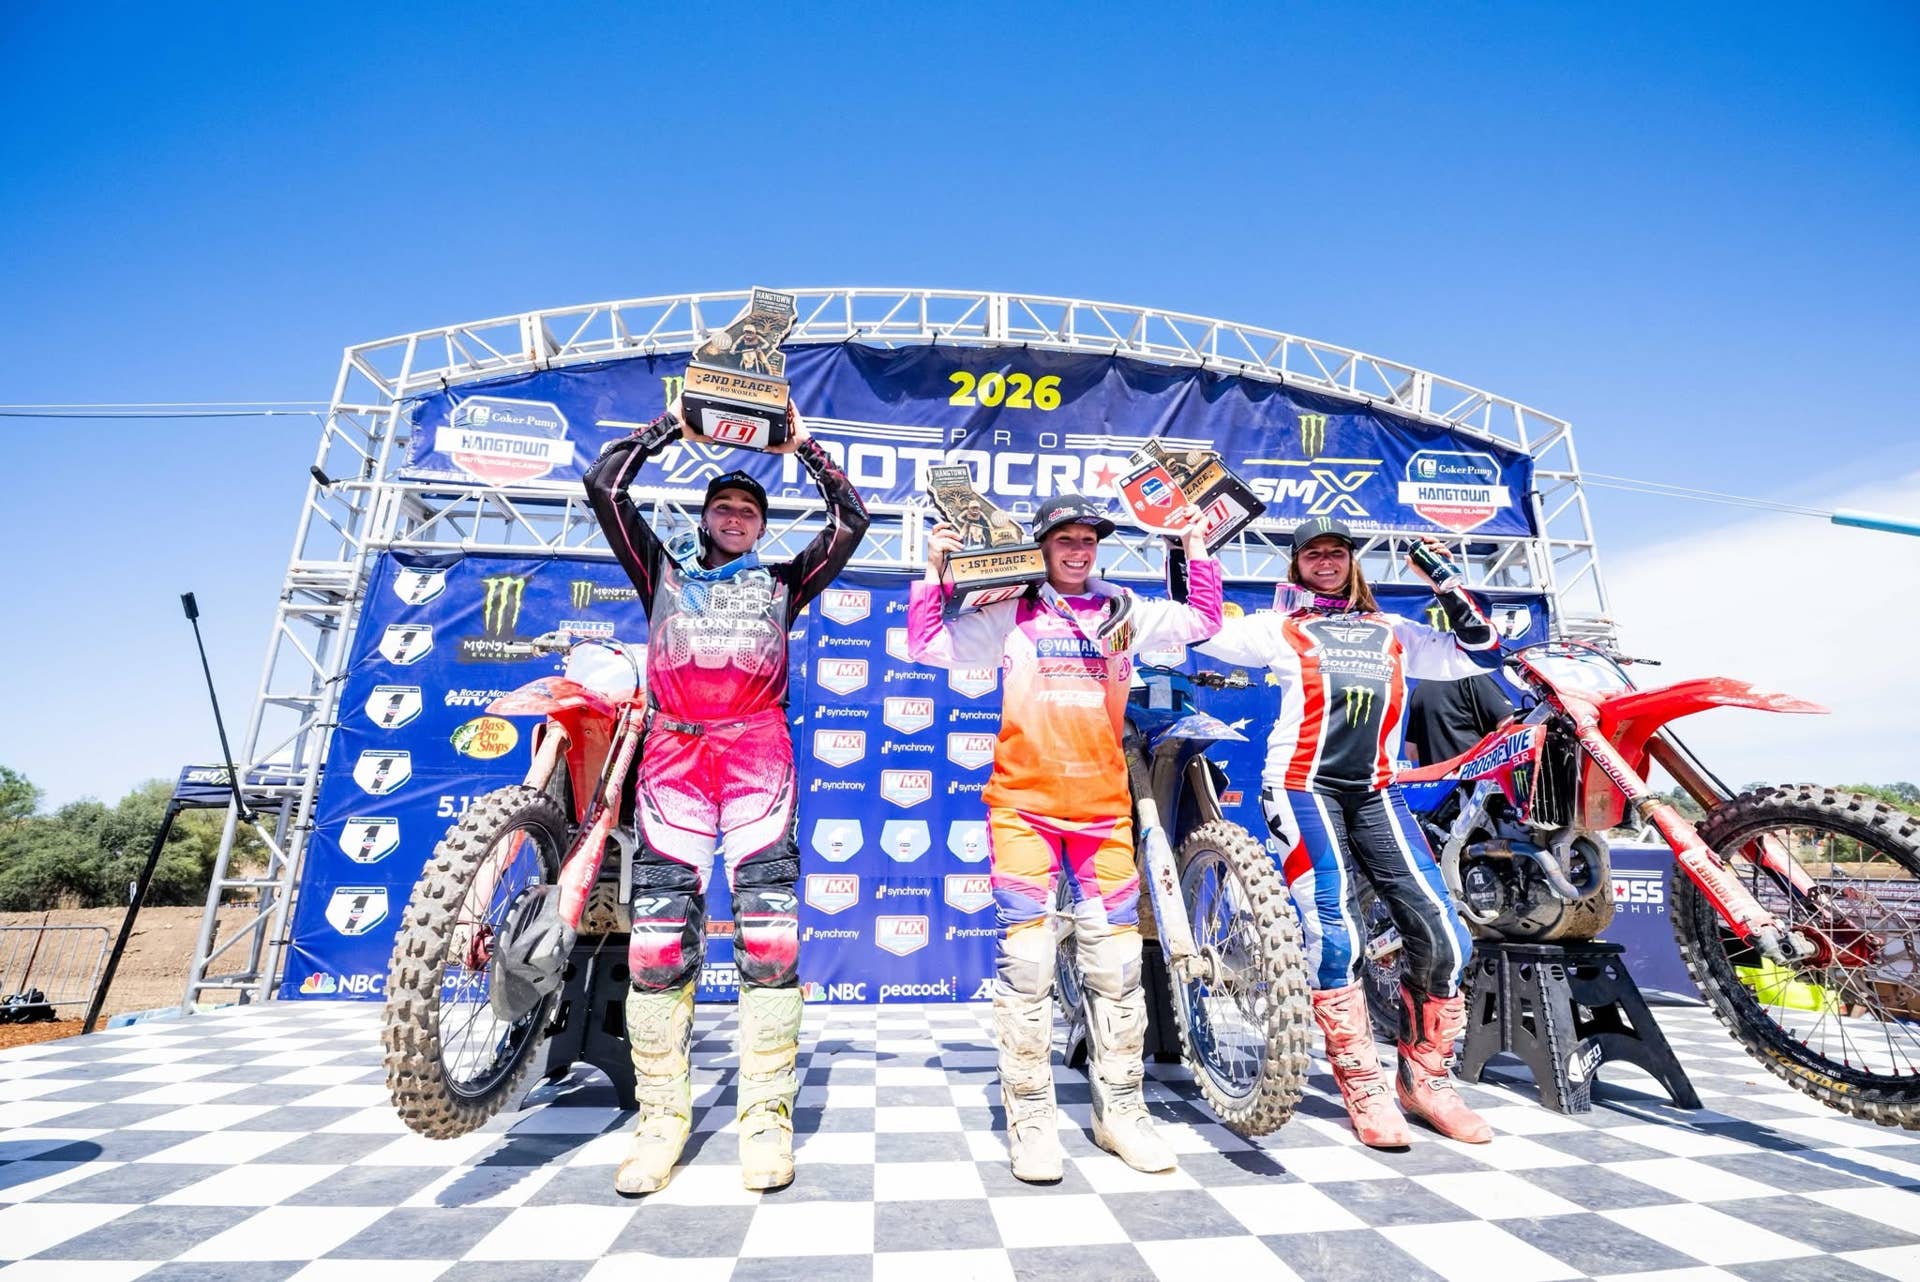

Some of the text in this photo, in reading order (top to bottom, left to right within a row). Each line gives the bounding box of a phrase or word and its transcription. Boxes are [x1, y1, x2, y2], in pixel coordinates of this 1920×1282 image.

[703, 374, 773, 393] 2ND PLACE
[948, 372, 1062, 411] 2026
[731, 388, 758, 398] WOMEN
[492, 412, 558, 430] Coker Pump
[461, 435, 550, 456] HANGTOWN
[951, 428, 1058, 449] PRO
[1438, 464, 1493, 480] Coker Pump
[1249, 470, 1375, 516] SMX
[1418, 488, 1490, 502] HANGTOWN
[968, 554, 1027, 569] 1ST PLACE
[713, 584, 772, 602] QUAD
[712, 600, 773, 618] LOCK
[560, 622, 614, 631] PARTS
[676, 618, 772, 633] HONDA
[394, 632, 417, 660] 1
[829, 636, 871, 648] synchrony
[1326, 648, 1398, 664] HONDA
[1320, 660, 1394, 672] SOUTHERN
[894, 670, 936, 682] synchrony
[383, 694, 404, 724] 1
[826, 706, 868, 718] synchrony
[960, 711, 1000, 722] synchrony
[480, 718, 506, 732] Bass
[478, 731, 499, 742] Pro
[476, 740, 509, 754] Shops
[892, 742, 934, 753] synchrony
[372, 758, 392, 789] 1
[1600, 752, 1638, 799] SHOWA
[822, 780, 866, 792] synchrony
[359, 826, 382, 858] 1
[886, 886, 931, 898] synchrony
[346, 896, 369, 929] 1
[814, 928, 860, 940] synchrony
[338, 974, 384, 993] NBC
[828, 982, 866, 1001] NBC
[880, 978, 950, 1004] peacock
[1580, 1043, 1602, 1072] UFO
[1765, 1047, 1850, 1094] DUNLOP
